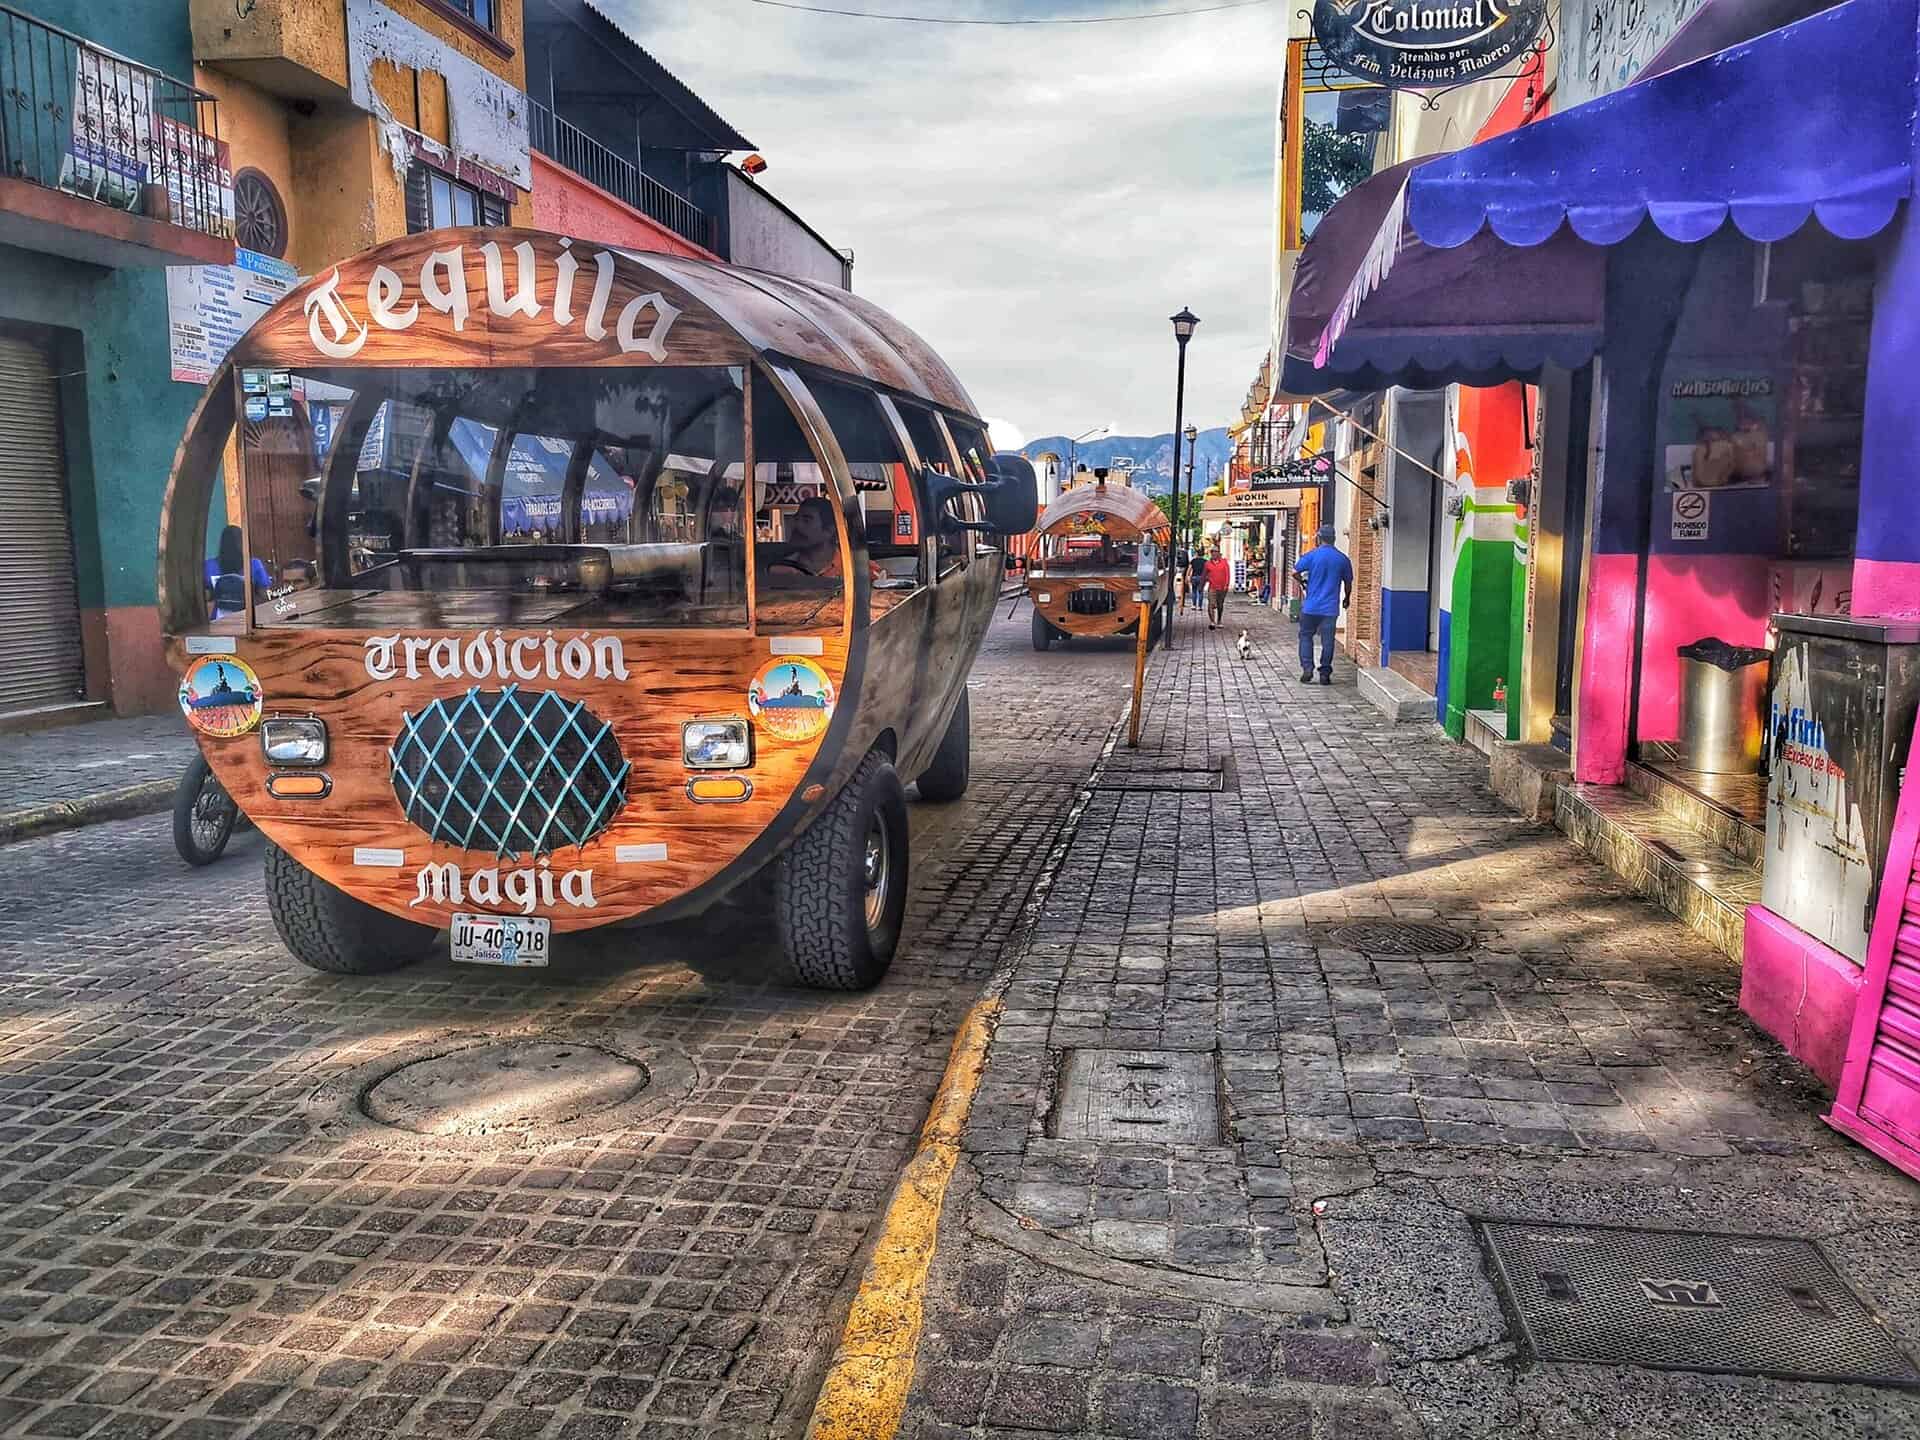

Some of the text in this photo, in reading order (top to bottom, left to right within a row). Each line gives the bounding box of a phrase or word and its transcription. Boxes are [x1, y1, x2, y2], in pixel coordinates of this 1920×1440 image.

[1372, 0, 1484, 34] Colonial
[1350, 44, 1511, 82] Fam. Velázquez Madero
[1399, 50, 1446, 63] Atendido
[303, 237, 682, 363] Tequila
[1235, 493, 1268, 501] WOKIN
[1673, 521, 1707, 530] PROHIBIDO
[1679, 530, 1703, 538] FUMAR
[364, 629, 630, 681] Tradición
[409, 857, 598, 914] Magia
[455, 926, 544, 951] JU-40-918
[474, 950, 502, 960] Jalisco
